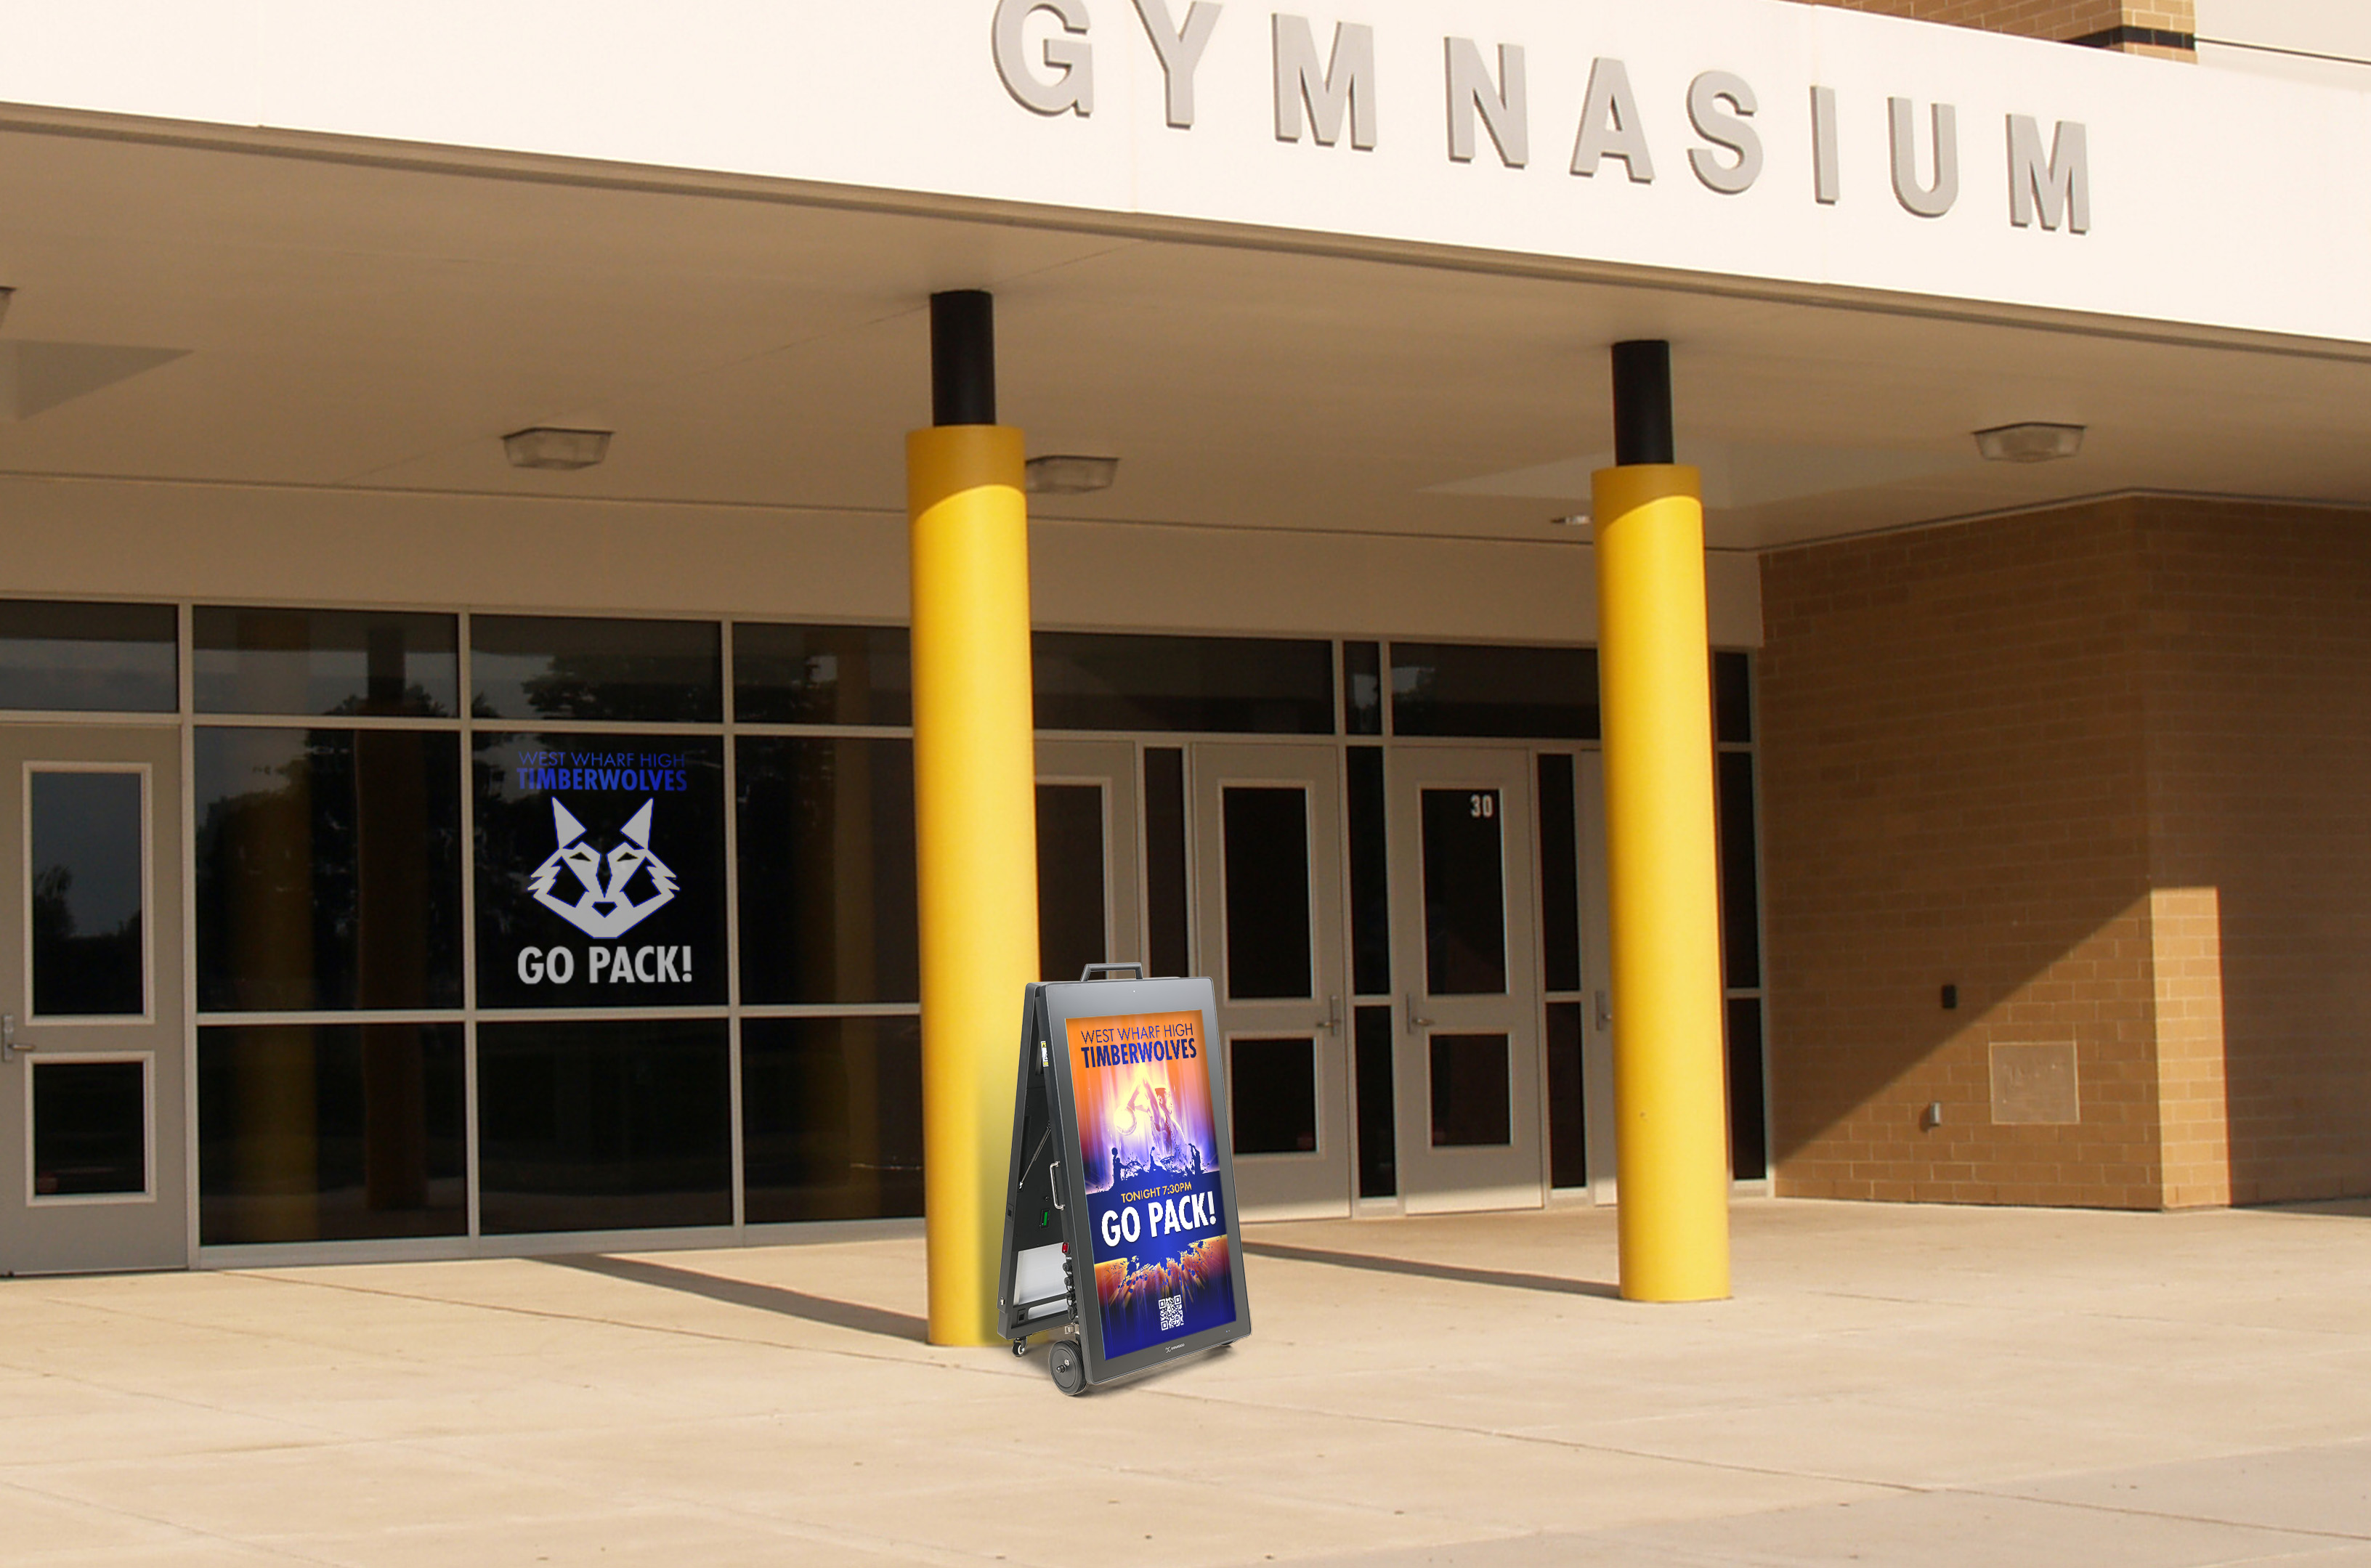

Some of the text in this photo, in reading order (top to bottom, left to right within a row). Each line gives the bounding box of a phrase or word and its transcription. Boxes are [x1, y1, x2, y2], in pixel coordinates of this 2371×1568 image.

[992, 0, 2091, 235] GYMNASIUM
[518, 751, 685, 768] WEST WHARF HIGH
[516, 768, 687, 791] TIMBERWOLVES
[1470, 795, 1493, 818] 30
[517, 946, 692, 984] GO PACK!
[1081, 1023, 1193, 1044] WEST WHARF HIGH
[1081, 1038, 1197, 1068] TIMBERWOLVES
[1121, 1181, 1192, 1203] TONIGHT 7:30PM
[1101, 1191, 1217, 1247] GO PACK!
